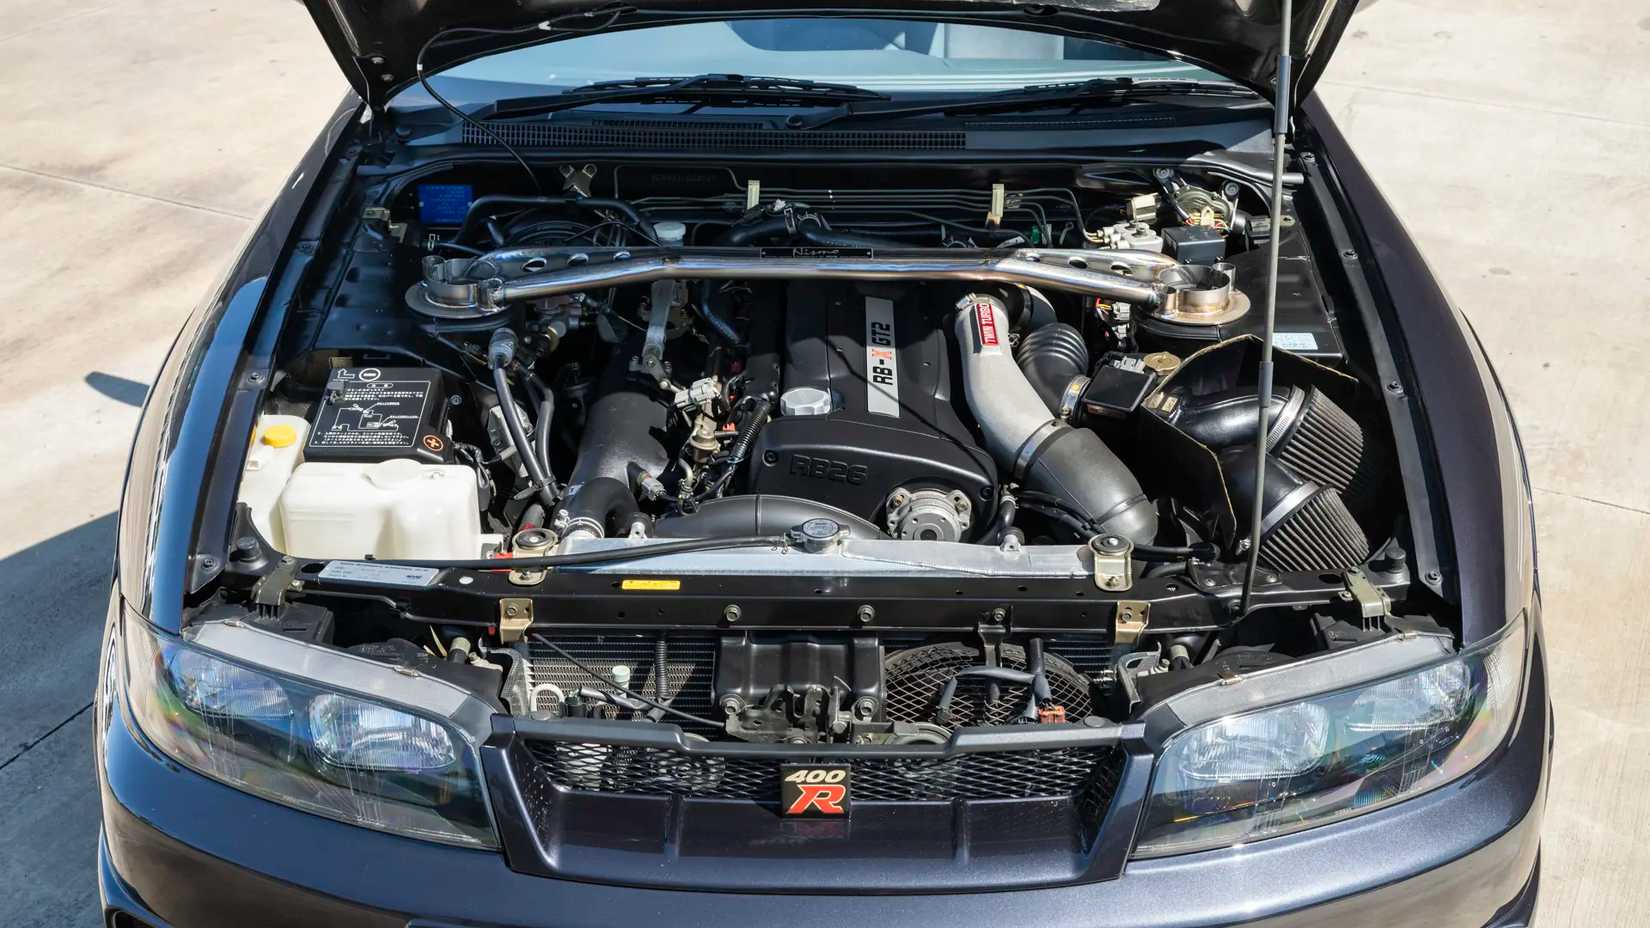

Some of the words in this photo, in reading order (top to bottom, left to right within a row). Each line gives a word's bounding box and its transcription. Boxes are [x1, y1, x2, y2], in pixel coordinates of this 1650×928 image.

[979, 303, 993, 325] TURBO
[871, 321, 892, 346] GT2
[982, 325, 996, 343] TWIN
[872, 348, 893, 385] RB-X
[790, 454, 869, 485] RB26
[785, 770, 846, 783] 400
[785, 784, 846, 814] R
